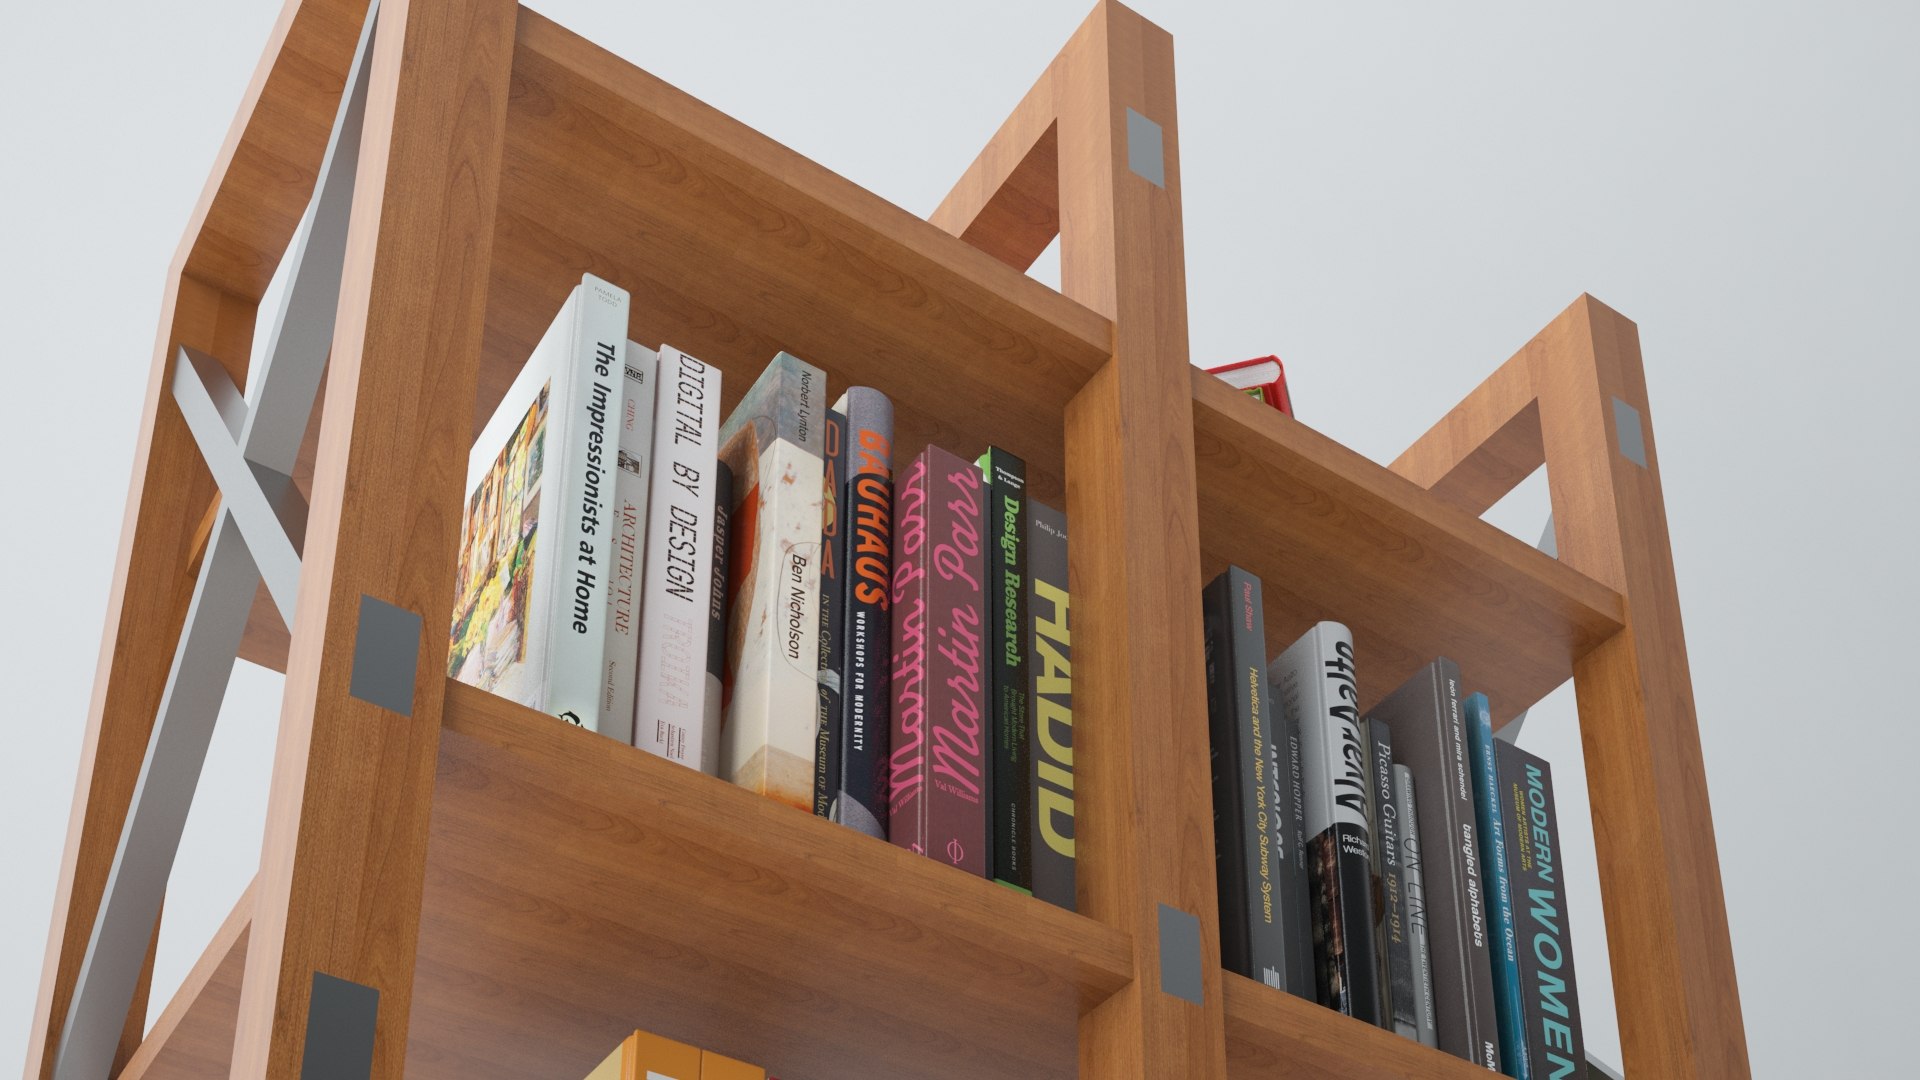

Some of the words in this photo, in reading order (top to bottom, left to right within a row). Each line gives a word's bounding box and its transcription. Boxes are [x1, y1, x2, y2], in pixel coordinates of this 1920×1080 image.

[595, 342, 616, 377] The
[674, 354, 706, 446] DIGITAL
[800, 370, 812, 408] Norbert
[626, 399, 636, 432] CHING
[798, 409, 812, 442] Lynton
[582, 382, 612, 536] Impressionists
[995, 466, 1024, 483] Thompson
[672, 461, 700, 498] BY
[821, 419, 840, 579] DADA
[714, 505, 728, 565] Jasper
[854, 428, 892, 611] BAUHAUS
[893, 461, 926, 604] Parr
[934, 468, 979, 592] Parr
[1000, 495, 1020, 566] Design
[1036, 520, 1055, 536] Philip
[578, 540, 597, 566] at
[615, 499, 639, 635] ARCHITECTURE
[666, 504, 698, 602] DESIGN
[792, 554, 807, 583] Ben
[572, 569, 596, 634] Home
[711, 567, 725, 621] Johns
[822, 594, 830, 606] IN
[1244, 582, 1252, 602] Paul
[788, 586, 806, 659] Nicholson
[821, 608, 829, 628] THE
[1004, 569, 1022, 667] Research
[1244, 604, 1252, 631] Shaw
[855, 612, 866, 668] WORKSHOPS
[607, 660, 617, 686] Second
[854, 672, 864, 690] FOR
[1250, 667, 1260, 715] Helvetica
[1325, 640, 1360, 732] Aalto
[605, 686, 615, 712] Edition
[820, 689, 830, 702] of
[890, 598, 925, 801] Martin
[933, 604, 980, 795] Martin
[1451, 698, 1460, 724] ferrari
[820, 706, 828, 726] THE
[854, 694, 864, 751] MODERNITY
[1034, 578, 1076, 858] HADID
[1252, 716, 1262, 738] and
[1453, 725, 1462, 742] and
[818, 728, 830, 773] Museum
[1254, 738, 1264, 756] the
[1290, 736, 1300, 779] EDWARD
[1456, 742, 1464, 760] mira
[1484, 744, 1493, 771] ERNST
[1255, 757, 1264, 784] New
[1334, 727, 1368, 823] Alvar
[1378, 741, 1390, 800] Picasso
[1458, 762, 1468, 800] schendel
[935, 779, 947, 792] Val
[948, 784, 979, 804] Williams
[1256, 785, 1266, 810] York
[1293, 780, 1302, 821] HOPPER
[1488, 774, 1497, 813] HAECKEL
[1257, 811, 1268, 832] City
[1383, 803, 1397, 866] Guitars
[1493, 817, 1502, 836] Art
[1526, 764, 1554, 883] MODERN
[1259, 832, 1270, 880] Subway
[1404, 838, 1421, 872] ON
[1462, 824, 1477, 876] tangled
[1495, 839, 1505, 874] Forms
[1263, 880, 1272, 924] System
[1498, 876, 1508, 902] from
[1408, 882, 1426, 935] LINE
[1467, 878, 1482, 947] alphabets
[1502, 906, 1511, 924] the
[1504, 927, 1514, 962] Ocean
[1528, 888, 1576, 1080] WOMEN
